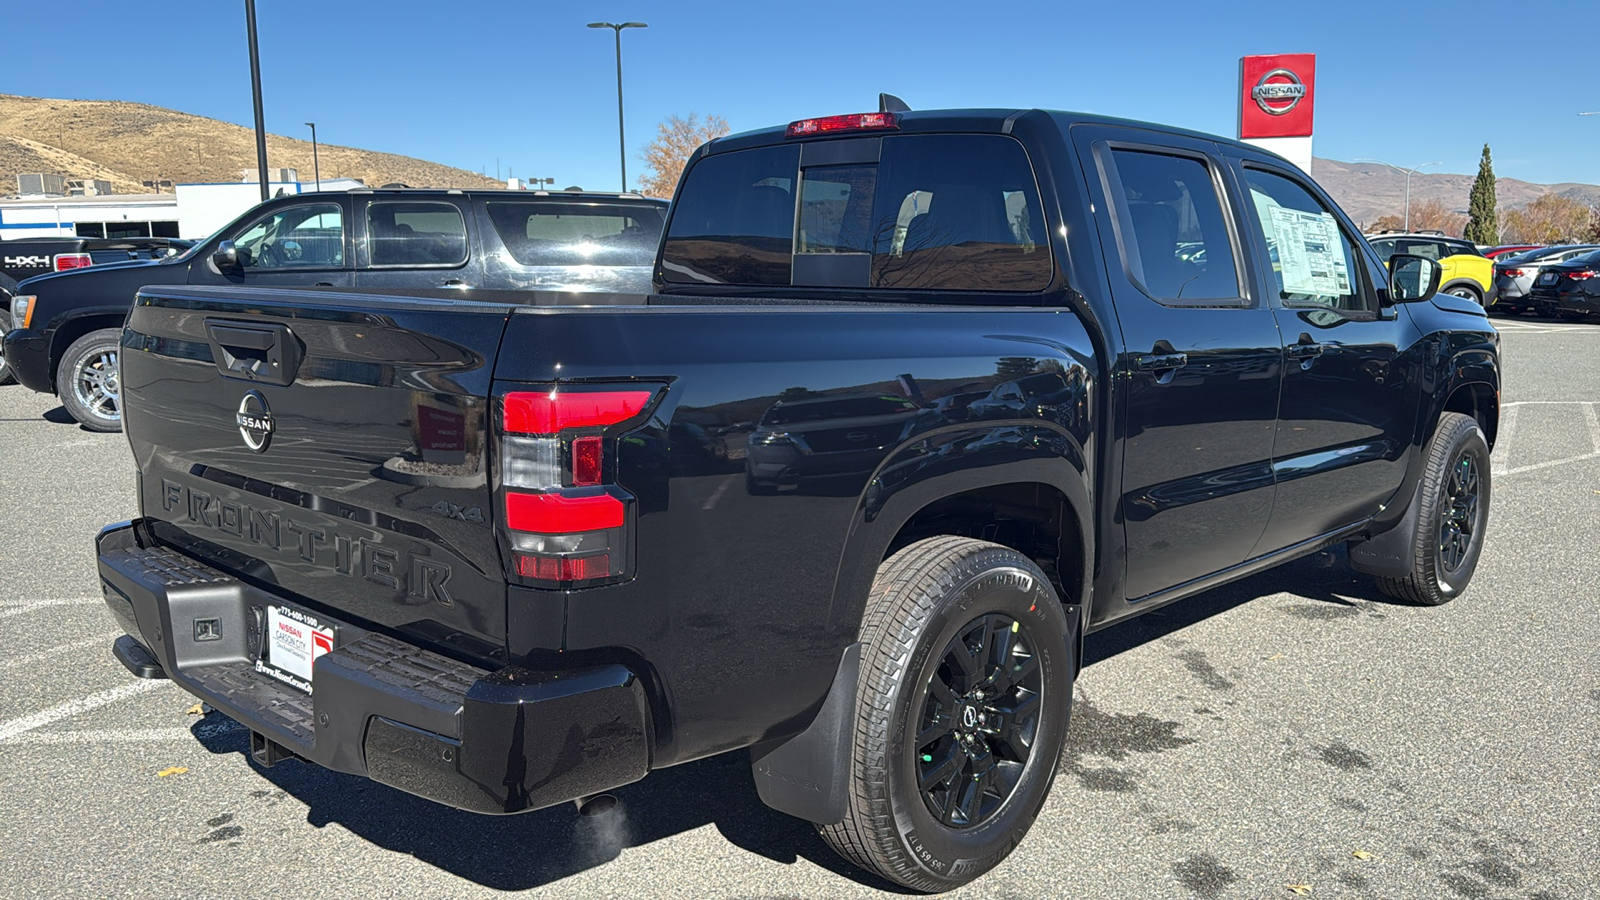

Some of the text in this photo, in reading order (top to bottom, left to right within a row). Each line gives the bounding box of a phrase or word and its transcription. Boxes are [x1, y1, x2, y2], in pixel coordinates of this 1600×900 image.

[1258, 86, 1302, 95] NISSAN
[162, 478, 454, 608] FRONTIER
[278, 621, 302, 639] NISSAN
[275, 630, 307, 651] CARSON CITY
[908, 835, 919, 845] 17
[915, 843, 924, 853] R
